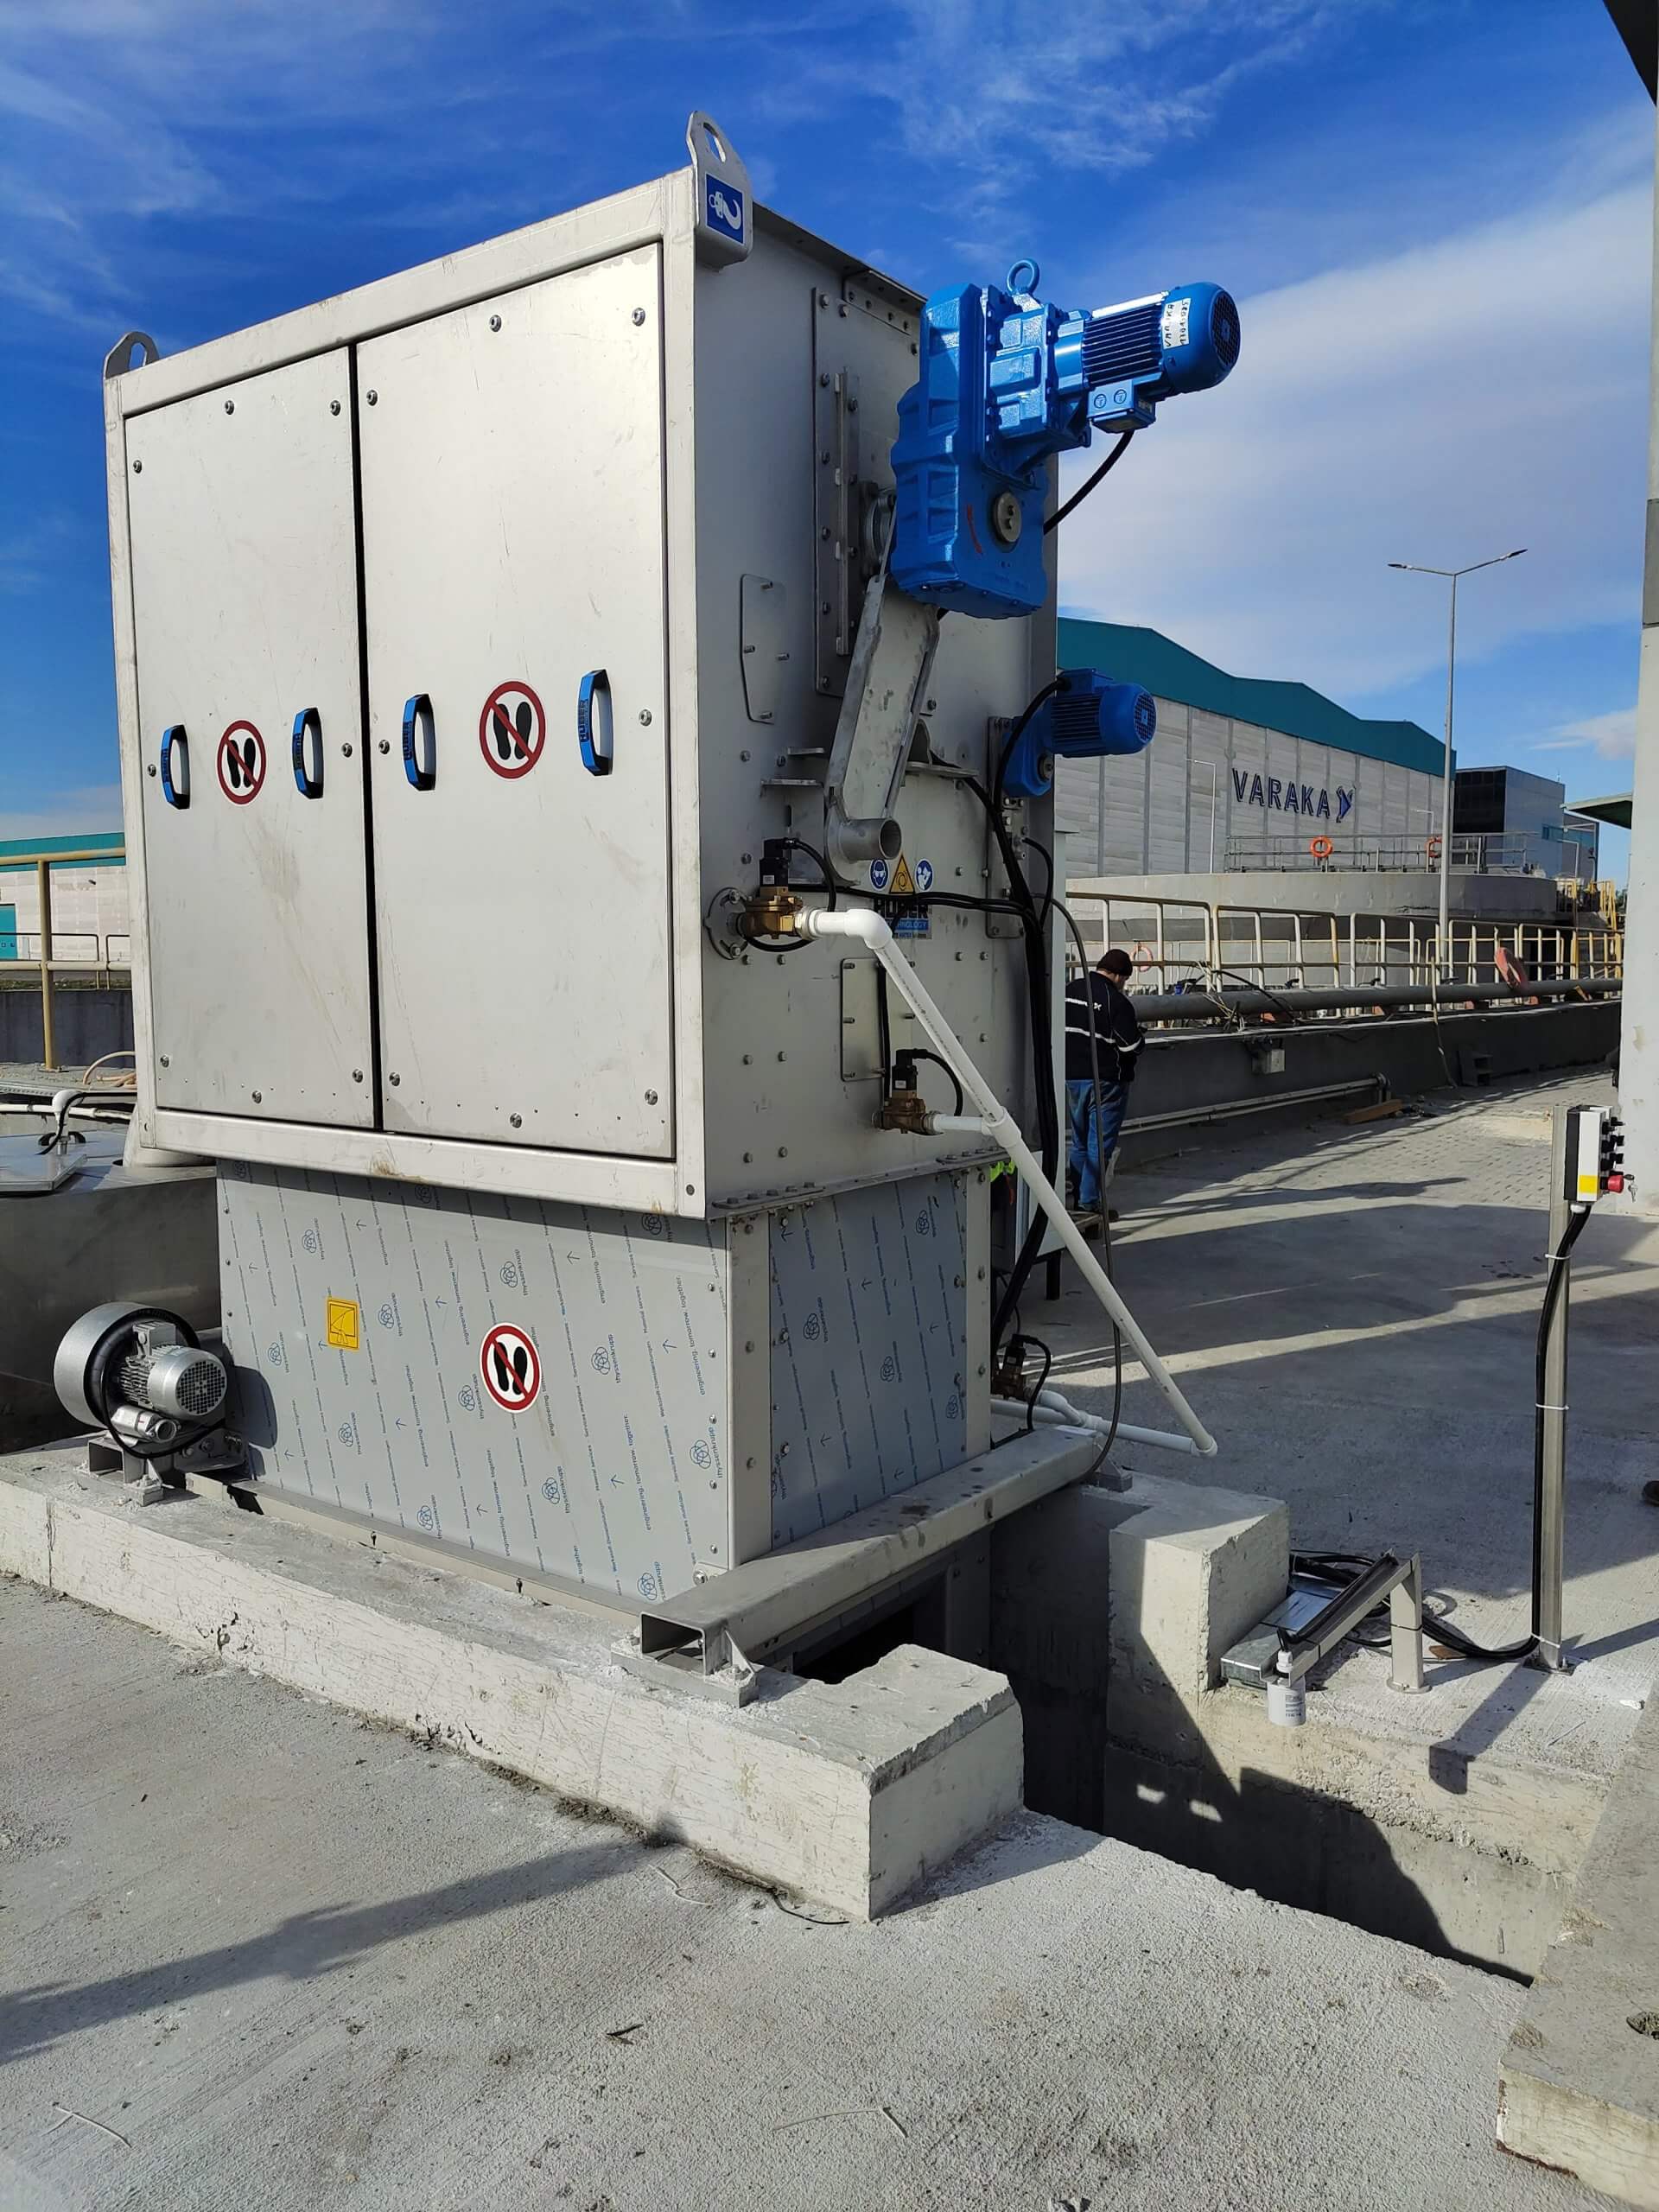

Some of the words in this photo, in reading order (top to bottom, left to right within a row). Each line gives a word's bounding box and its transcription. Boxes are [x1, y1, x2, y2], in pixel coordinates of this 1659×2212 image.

[1232, 767, 1331, 819] VARAKA
[607, 1332, 621, 1383] thyssenkrupp
[691, 1347, 706, 1395] engineering.
[708, 1426, 723, 1478] thyssenkrupp
[557, 1465, 571, 1514] thyssenkrupp
